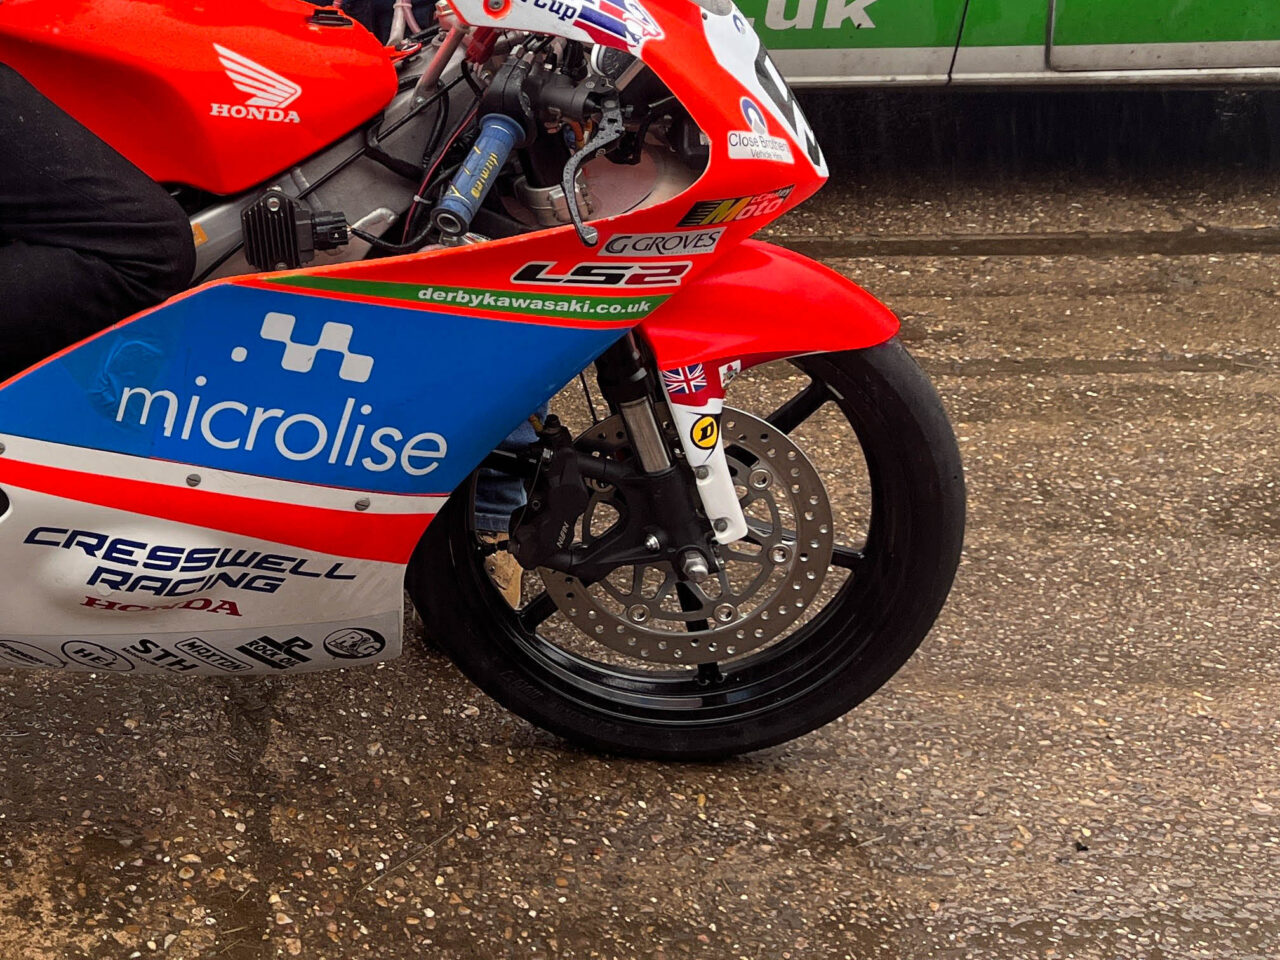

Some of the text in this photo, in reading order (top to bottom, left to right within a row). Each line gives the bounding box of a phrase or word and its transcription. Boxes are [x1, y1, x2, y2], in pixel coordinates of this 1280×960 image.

[210, 103, 301, 123] HONDA
[729, 133, 759, 147] Close
[632, 231, 721, 254] GROVES
[511, 262, 690, 286] LS2
[418, 287, 651, 314] derbykawasaki.co.uk
[115, 376, 448, 476] microlise
[23, 527, 357, 581] CRESSWELL
[86, 565, 287, 597] RACING
[80, 596, 243, 617] HONDA
[130, 638, 200, 672] STH
[181, 641, 246, 671] MAXTON
[246, 640, 281, 660] ROCK
